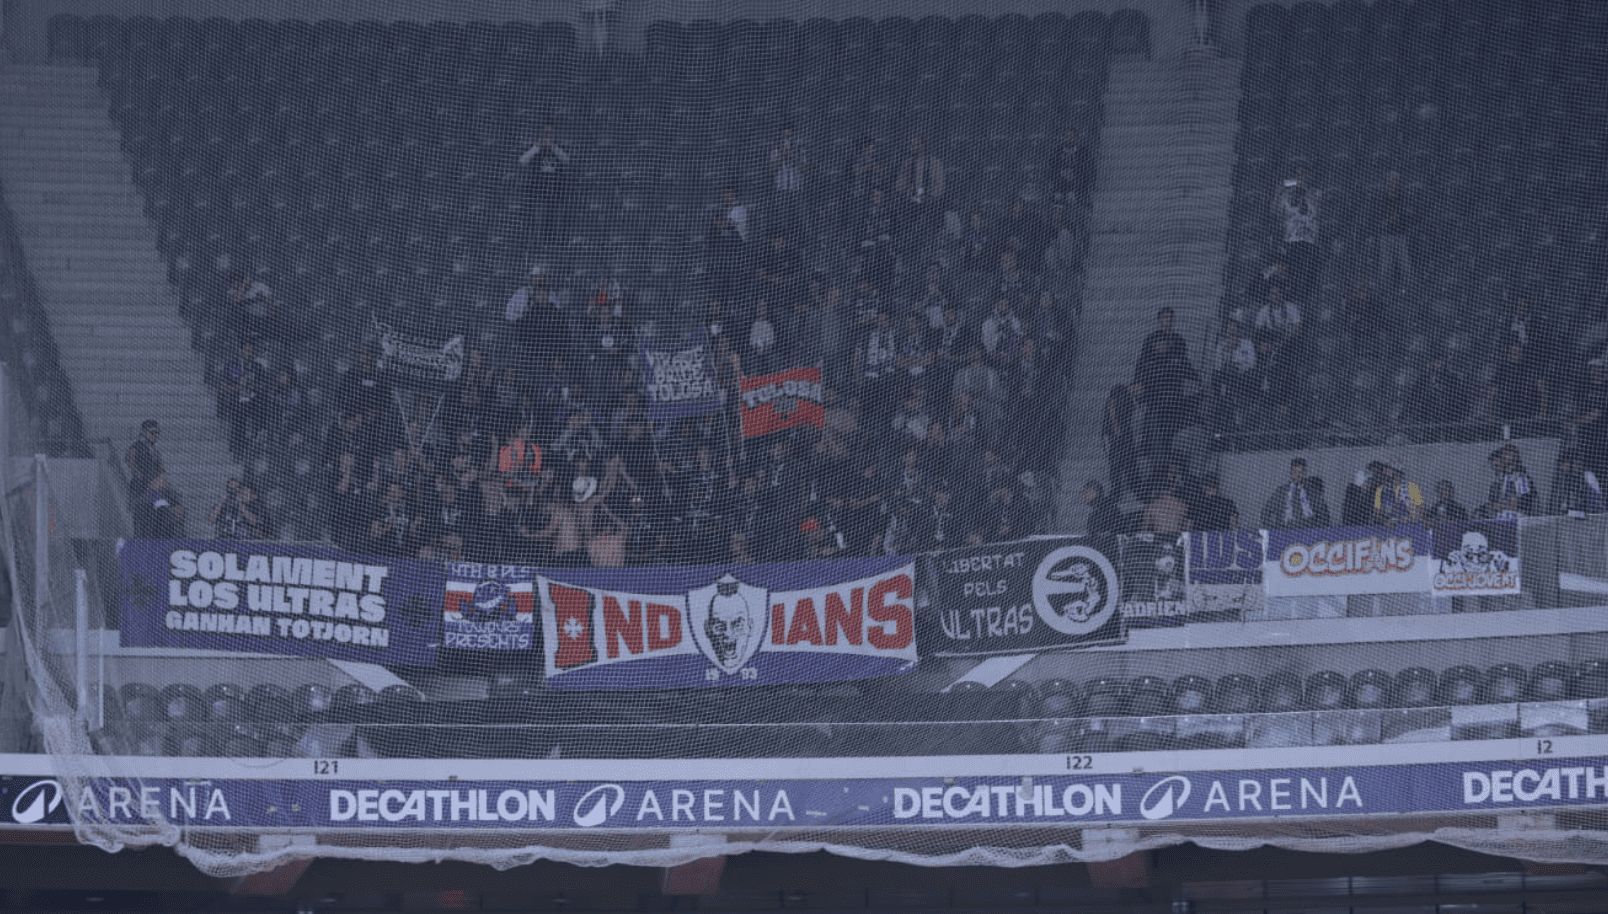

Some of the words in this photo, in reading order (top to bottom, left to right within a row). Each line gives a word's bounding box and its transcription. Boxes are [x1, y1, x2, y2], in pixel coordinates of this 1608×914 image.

[648, 378, 714, 403] TOLOSA
[741, 380, 824, 409] TOLOSA
[170, 550, 388, 594] SOLAMENT
[945, 552, 1025, 574] LIBERTAT
[1281, 537, 1413, 577] OCCIFANS
[169, 580, 238, 609] LOS
[246, 587, 386, 622] ULTRAS
[963, 579, 1008, 598] PELS
[940, 603, 1034, 640] ULTRAS
[1123, 601, 1187, 617] ADRIEN
[166, 610, 270, 637] GANHAN
[280, 618, 389, 647] TOTJORN
[445, 632, 530, 649] PRESENTS
[893, 783, 1121, 818] DECATHLON
[1204, 776, 1362, 812] ARENA
[1463, 766, 1608, 804] DECATH
[77, 787, 231, 821] ARENA
[330, 789, 555, 822] DECATHLON
[637, 790, 794, 822] ARENA
